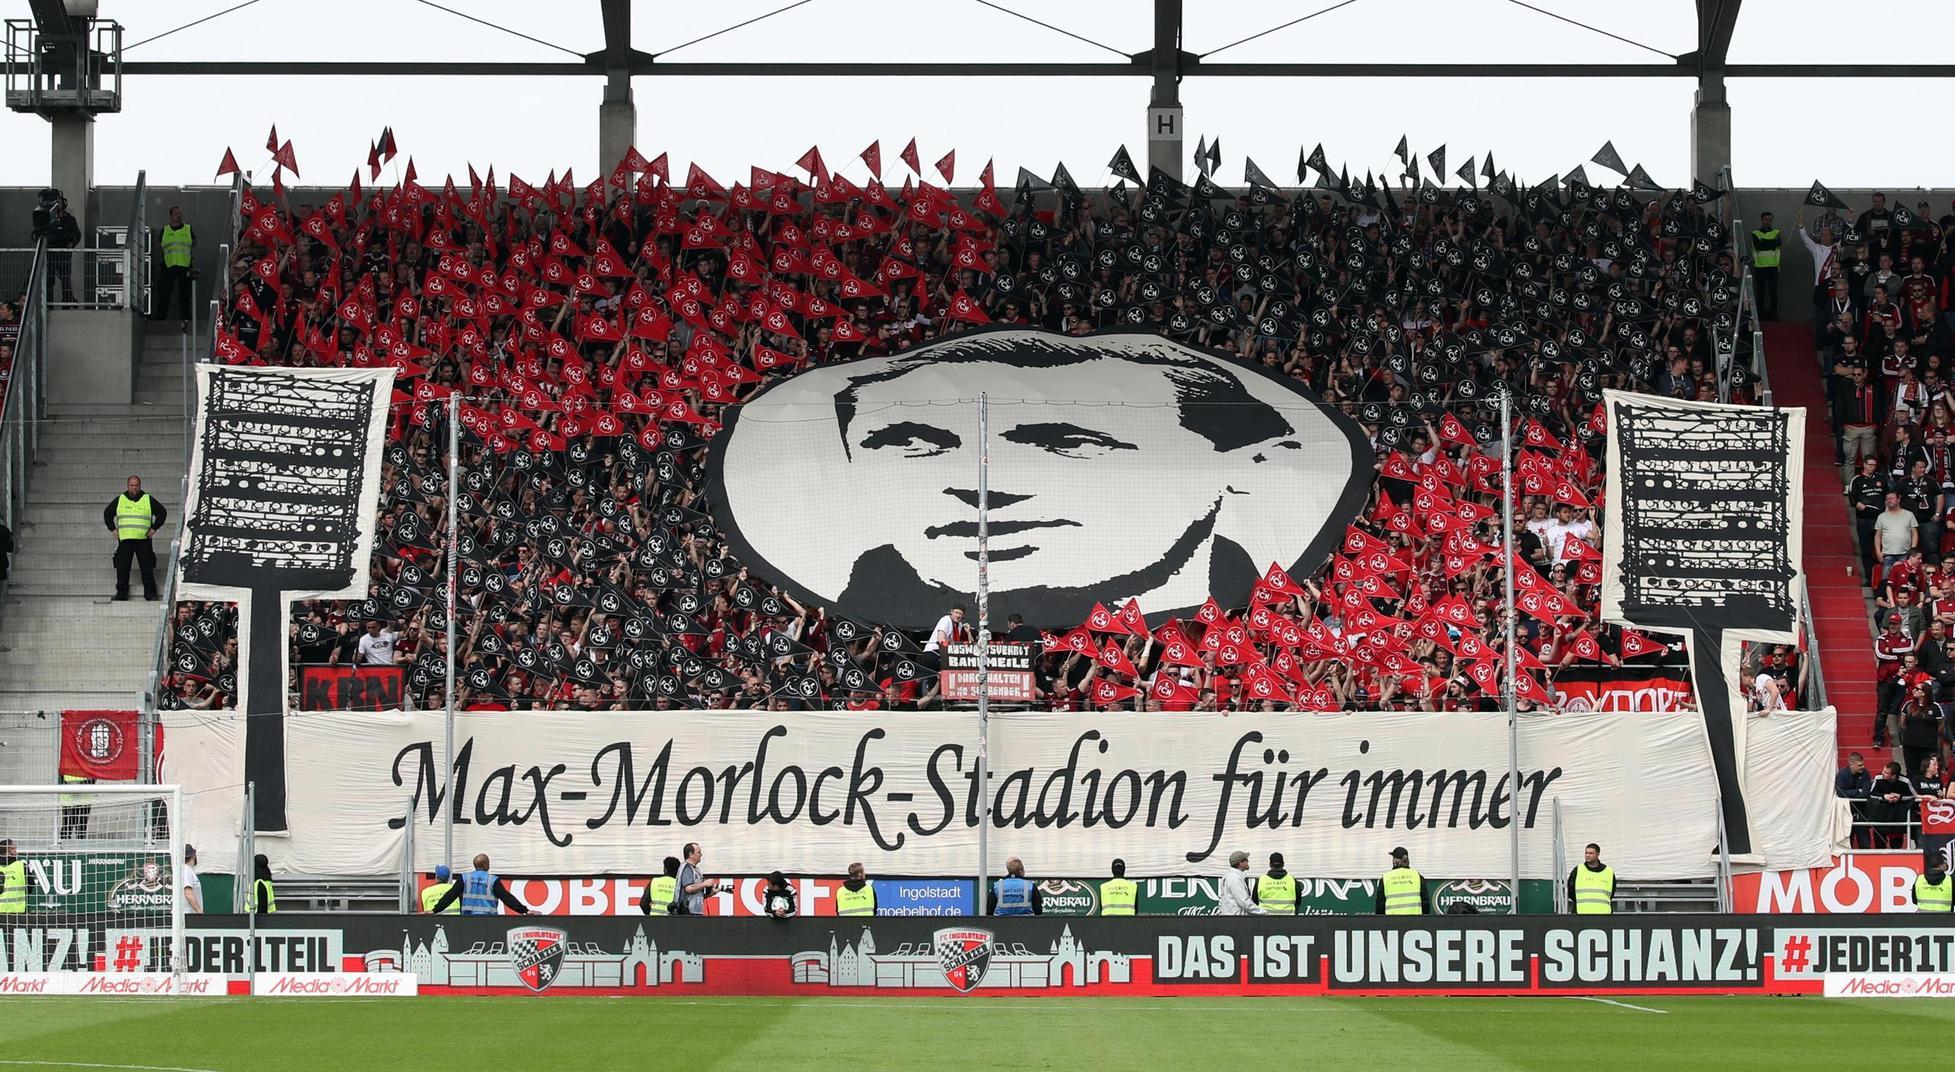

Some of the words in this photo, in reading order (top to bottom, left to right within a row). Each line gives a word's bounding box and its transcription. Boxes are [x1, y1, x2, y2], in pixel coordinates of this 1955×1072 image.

[1158, 115, 1174, 134] H
[949, 656, 1030, 668] BANMEILE
[1186, 731, 1328, 864] für
[1340, 740, 1562, 830] immer
[900, 886, 962, 900] Ingolstadt
[1757, 855, 1920, 913] MÖB
[1041, 896, 1090, 907] RNBRÄU
[877, 906, 962, 916] moebelhof.de
[516, 942, 562, 971] SCHANZER
[943, 943, 989, 972] SCHANZER
[1158, 935, 1235, 979] DAS
[1253, 935, 1315, 979] IST
[1334, 929, 1525, 982] UNSERE
[1545, 929, 1759, 982] SCHANZ!
[269, 977, 331, 993] Media
[344, 977, 400, 993] Markt
[1840, 977, 1901, 994] Media
